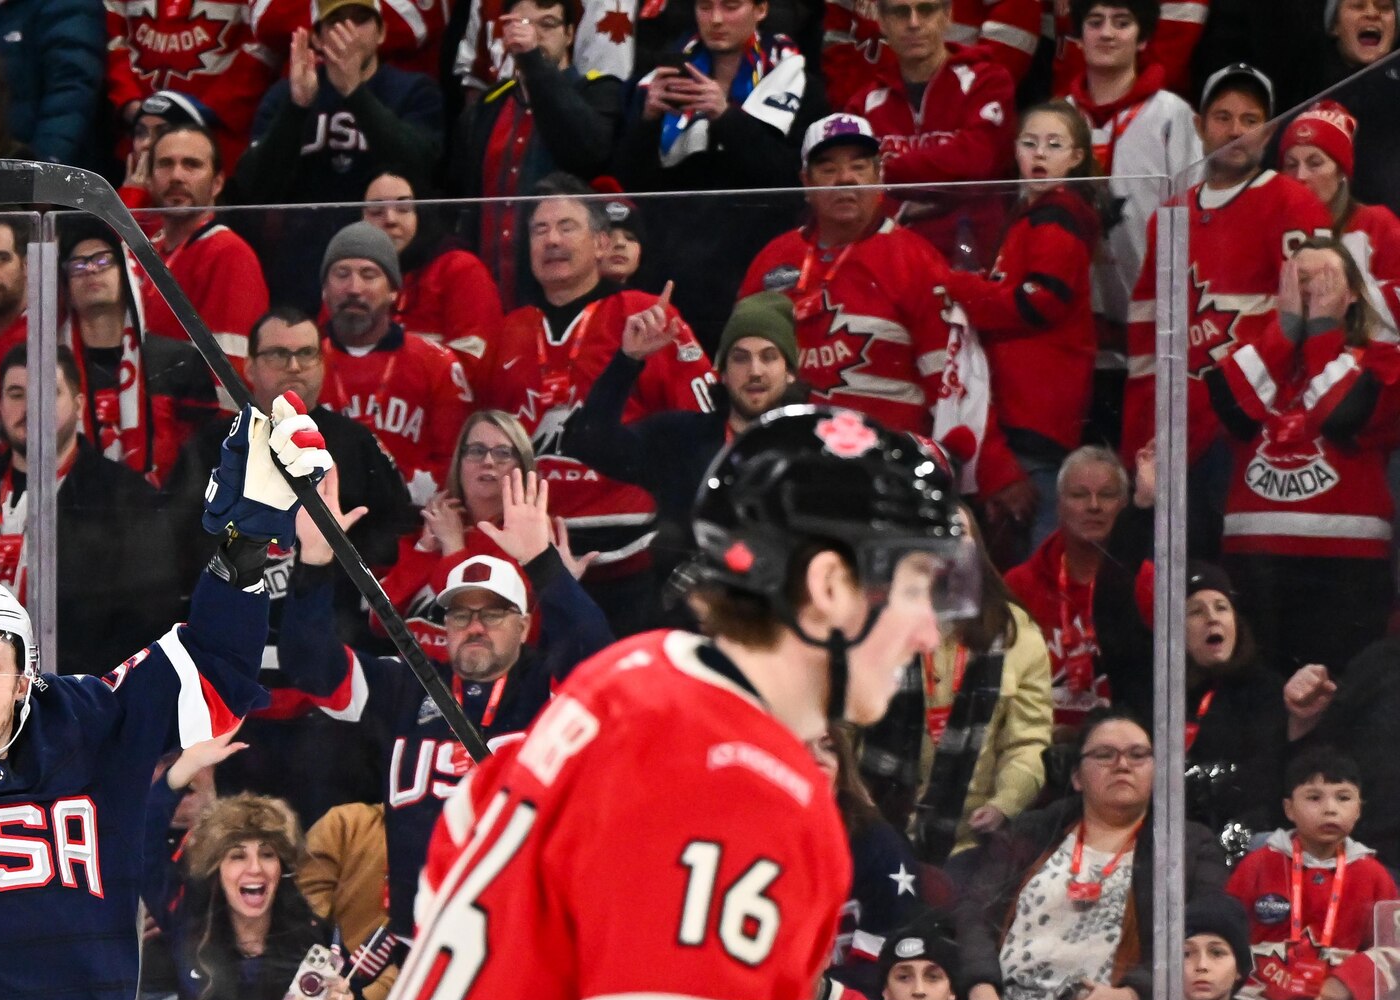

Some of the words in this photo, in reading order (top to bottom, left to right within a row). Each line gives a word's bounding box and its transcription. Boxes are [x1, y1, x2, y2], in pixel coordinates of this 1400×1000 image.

[136, 22, 210, 53] CANADA
[1245, 463, 1334, 498] CANADA
[389, 733, 526, 810] US
[677, 837, 784, 969] 16
